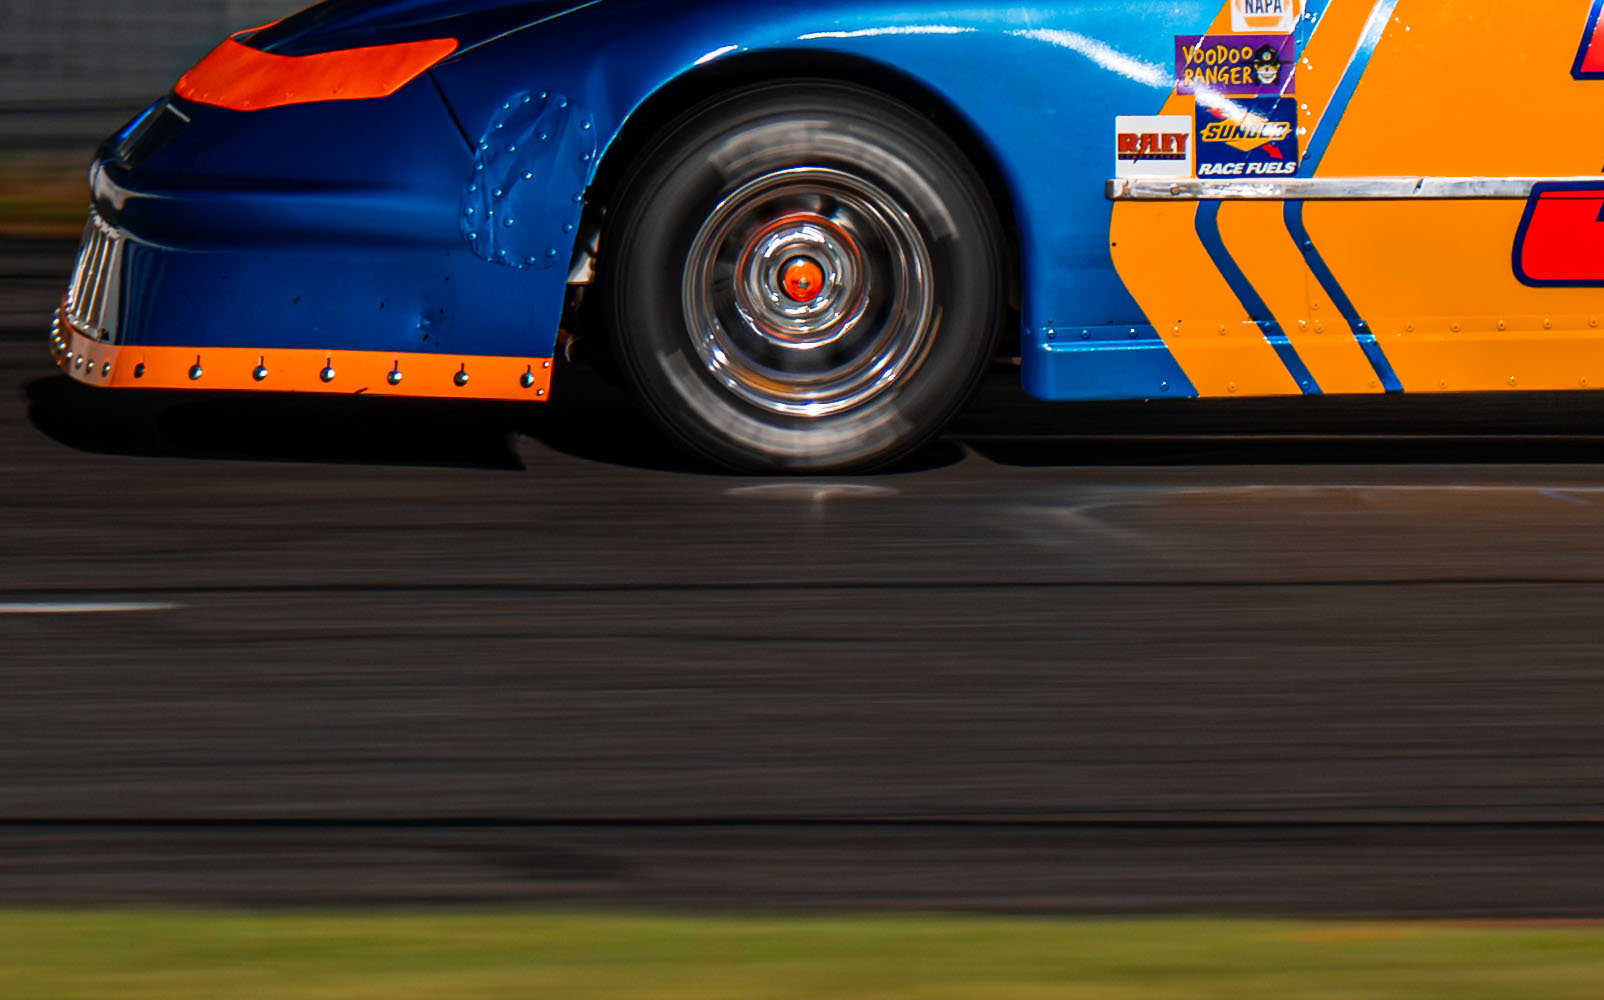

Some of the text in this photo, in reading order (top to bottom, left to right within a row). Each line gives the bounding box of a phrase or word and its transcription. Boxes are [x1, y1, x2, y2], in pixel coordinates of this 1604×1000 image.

[1182, 45, 1253, 66] VOODOO
[1184, 66, 1253, 85] RANGER
[1205, 125, 1287, 139] SUNO
[1198, 162, 1297, 175] RACE FUELS
